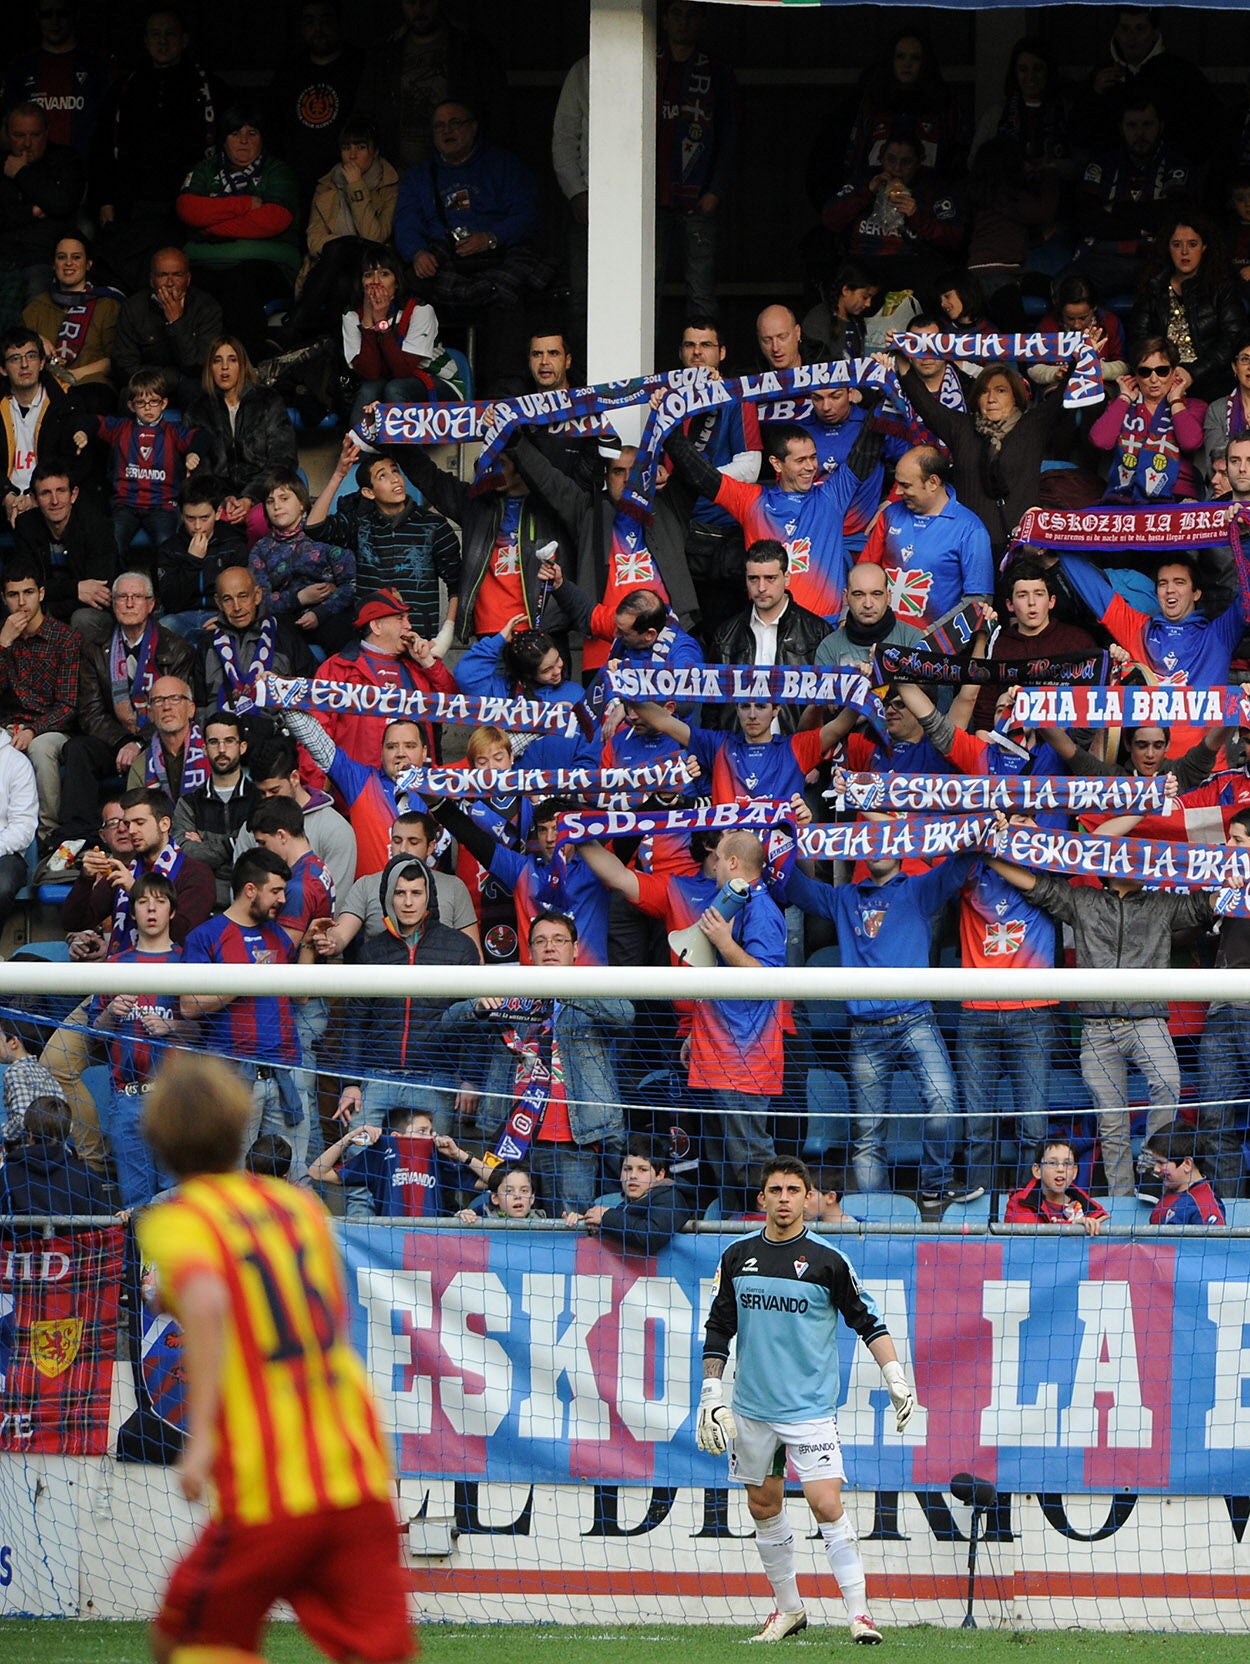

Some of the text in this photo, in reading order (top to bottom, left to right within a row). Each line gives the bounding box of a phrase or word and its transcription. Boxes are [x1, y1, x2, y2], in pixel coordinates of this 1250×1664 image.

[31, 96, 84, 111] RVANDO
[1014, 332, 1049, 357] LA
[515, 389, 573, 417] URTE
[575, 387, 596, 398] 2001
[643, 374, 662, 385] 2011
[667, 366, 713, 389] GOR
[739, 373, 783, 398] LA
[793, 357, 888, 387] BRAVA
[1037, 511, 1136, 533] ESKOZIA
[1144, 513, 1172, 533] LA
[1179, 509, 1226, 533] BRA
[608, 668, 872, 706] ESKOZIA LA BRAVA
[311, 680, 570, 730] ESKOZIA LA BRAVA
[1087, 691, 1123, 722] LA
[1132, 691, 1223, 722] BRAVA
[558, 768, 592, 790] LA
[889, 777, 1163, 811] ESKOZIA LA BRAVA
[564, 811, 656, 838] S.D.
[882, 823, 914, 856] LA
[1011, 830, 1132, 876] ESKOZIA
[1142, 840, 1181, 877] LA
[740, 1293, 809, 1314] SERVANDO
[357, 1267, 928, 1447] ESKOA
[980, 1280, 1153, 1450] LA
